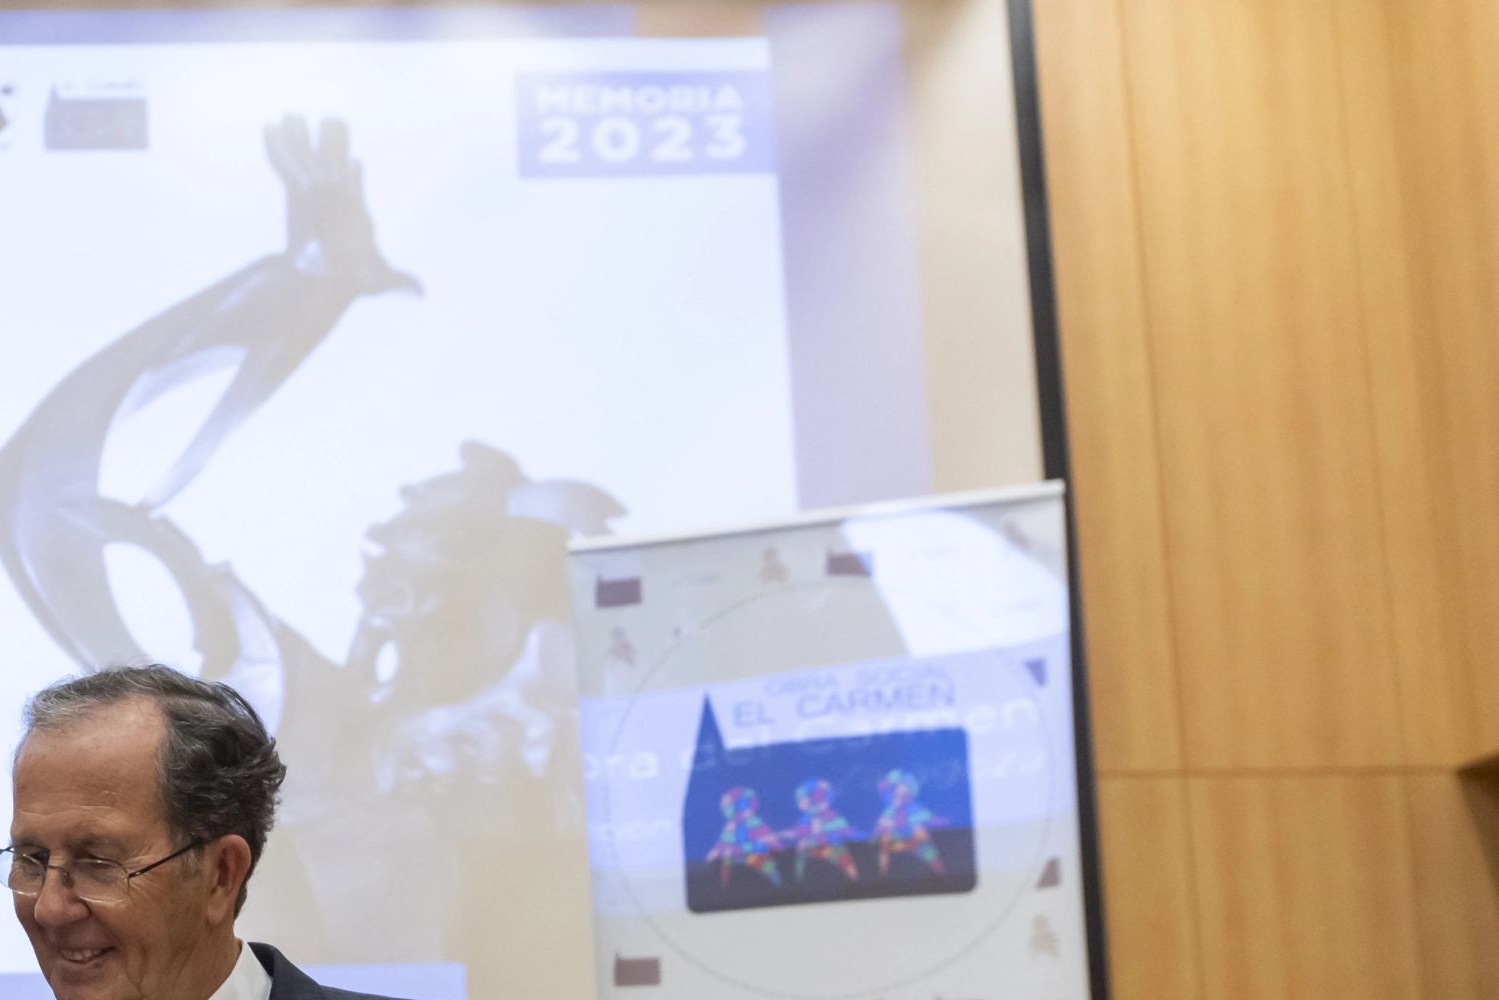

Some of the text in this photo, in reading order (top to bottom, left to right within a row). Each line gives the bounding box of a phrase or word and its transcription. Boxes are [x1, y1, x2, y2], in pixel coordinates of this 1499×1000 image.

[539, 113, 746, 163] 2023
[732, 681, 957, 729] EL CARMEN
